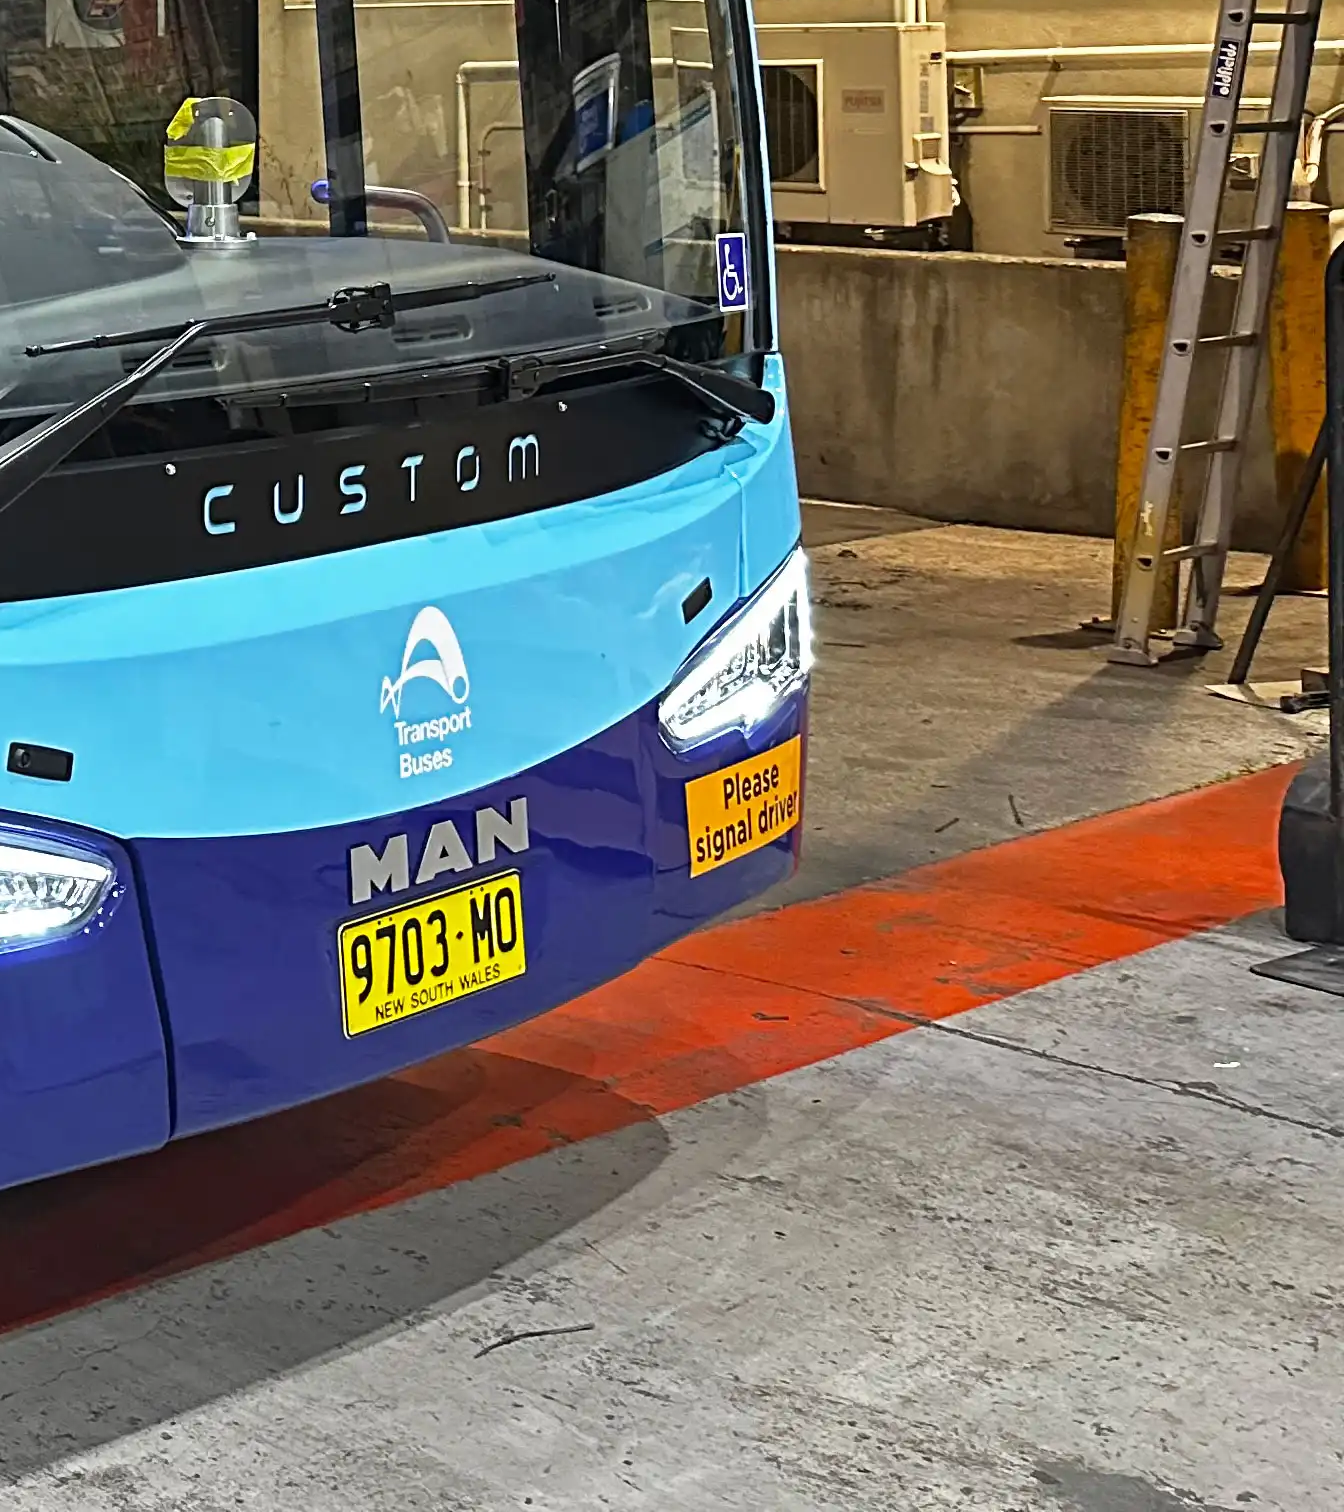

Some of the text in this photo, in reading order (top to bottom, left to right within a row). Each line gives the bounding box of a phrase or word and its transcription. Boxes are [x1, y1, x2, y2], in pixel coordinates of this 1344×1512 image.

[1214, 43, 1238, 96] oldfields
[203, 433, 540, 535] CUSTOM
[394, 705, 472, 746] Transport
[399, 747, 454, 779] Buses
[723, 763, 780, 810] Please
[348, 795, 530, 905] MAN
[696, 790, 798, 863] signal driver
[375, 962, 501, 1022] NEW SOUTH WALES
